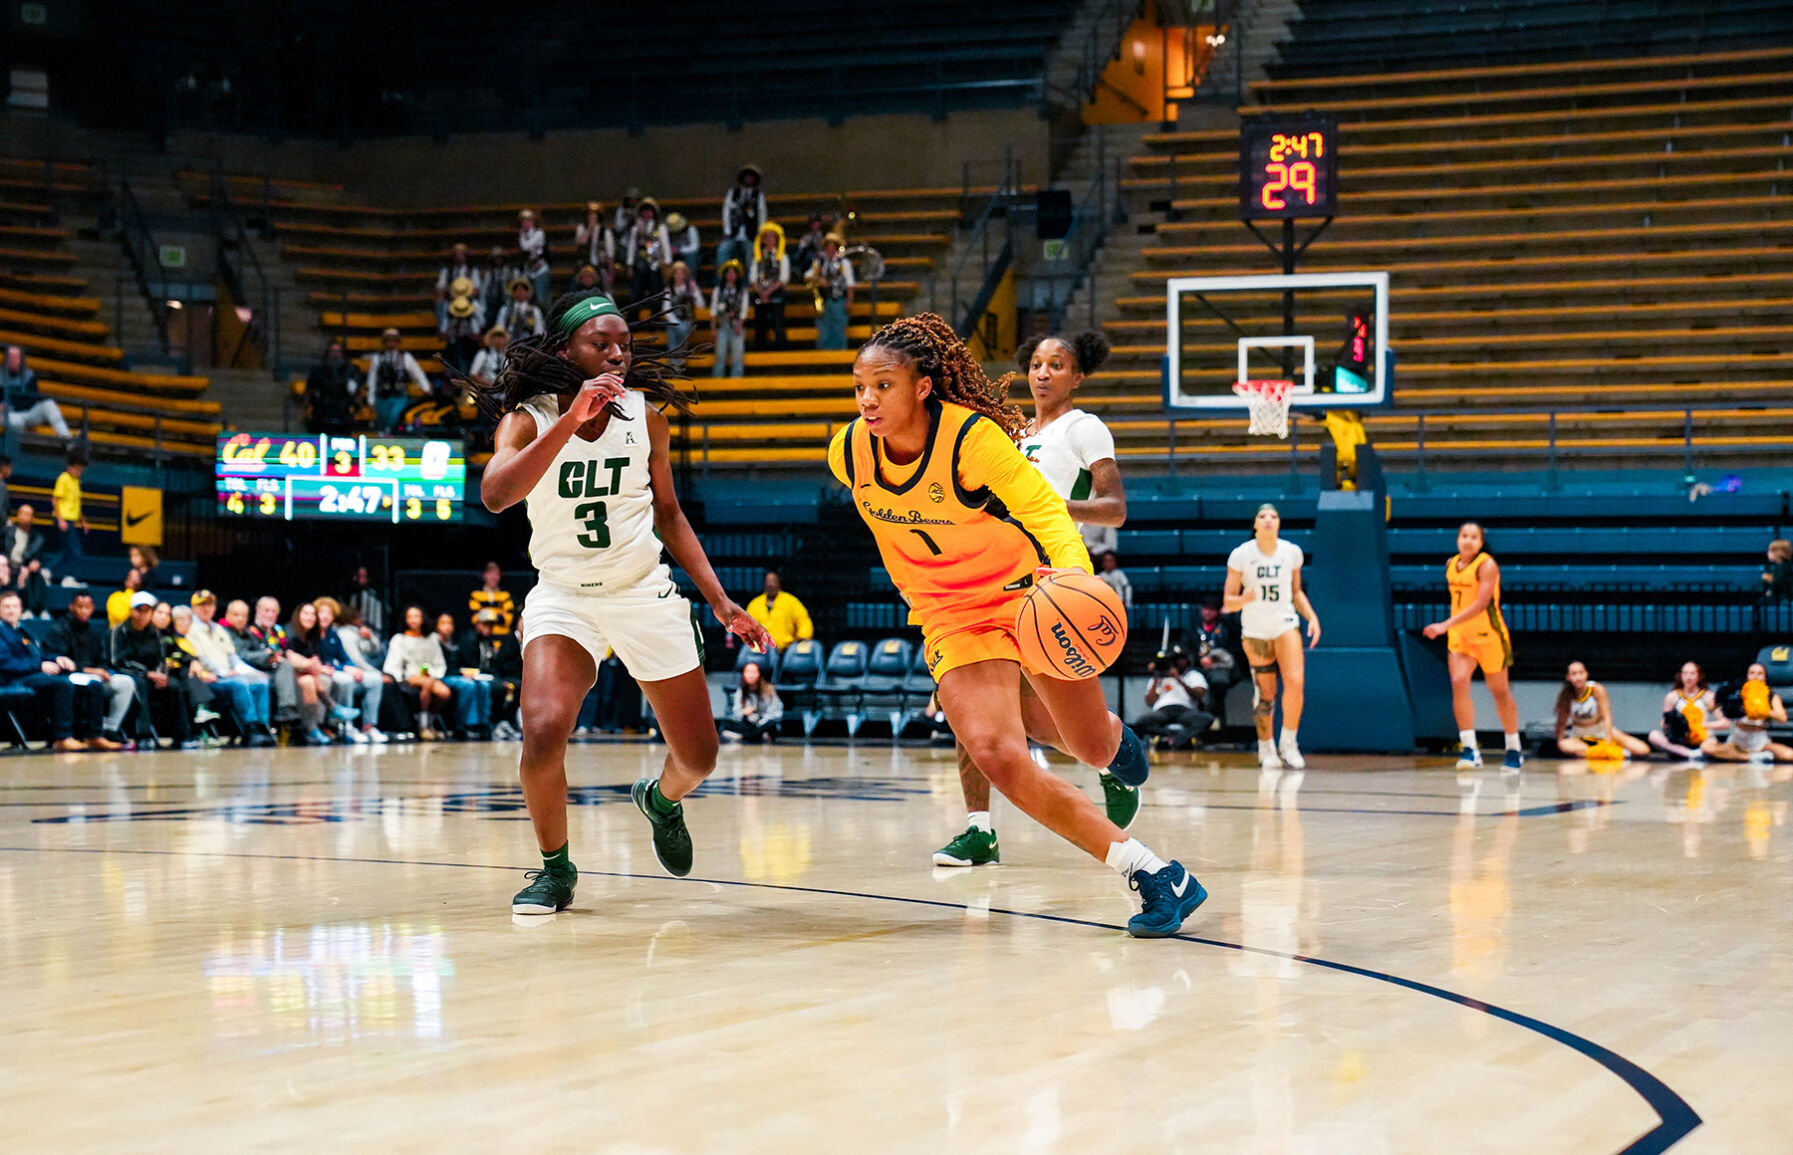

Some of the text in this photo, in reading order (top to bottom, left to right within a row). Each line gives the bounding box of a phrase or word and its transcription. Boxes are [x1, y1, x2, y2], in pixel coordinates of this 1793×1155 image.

[1269, 132, 1324, 162] 2:47
[1261, 161, 1317, 210] 29
[222, 433, 317, 472] Cal 40
[334, 450, 352, 474] 3
[371, 444, 406, 472] 33
[558, 457, 630, 498] CLT
[259, 492, 277, 516] 3
[319, 484, 382, 514] 2:47
[406, 497, 422, 520] 3
[862, 501, 957, 526] Golden Bears
[574, 501, 612, 549] 3
[909, 529, 943, 556] 1
[1257, 565, 1281, 578] CLT
[1261, 585, 1280, 602] 15
[1087, 614, 1119, 647] Cal
[1050, 621, 1097, 678] Wilson
